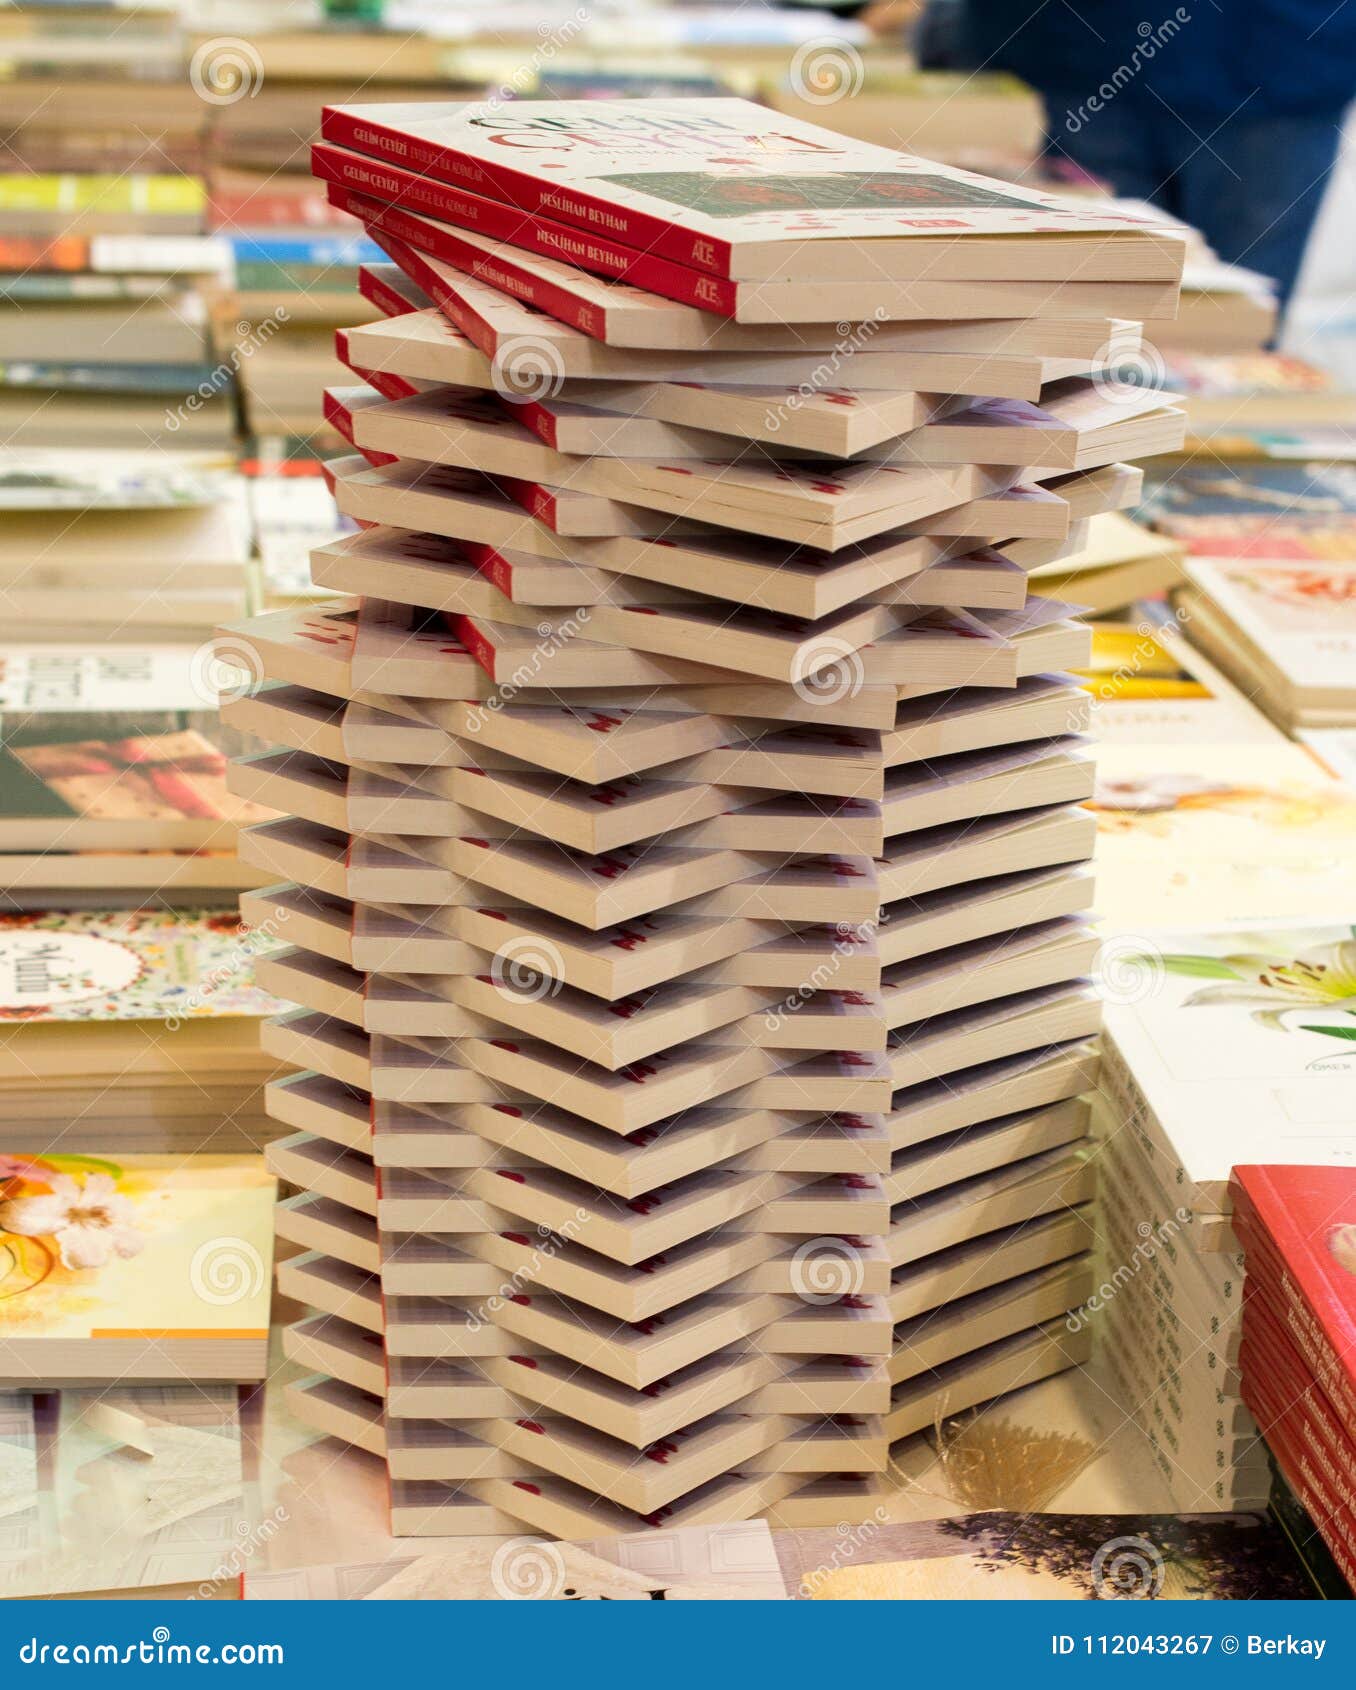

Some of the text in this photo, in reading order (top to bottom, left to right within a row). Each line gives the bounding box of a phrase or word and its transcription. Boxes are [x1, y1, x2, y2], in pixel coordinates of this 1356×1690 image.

[539, 192, 628, 233] NESLİHAN BEYHAN
[536, 228, 628, 270] NESLİHAN BEYHAN
